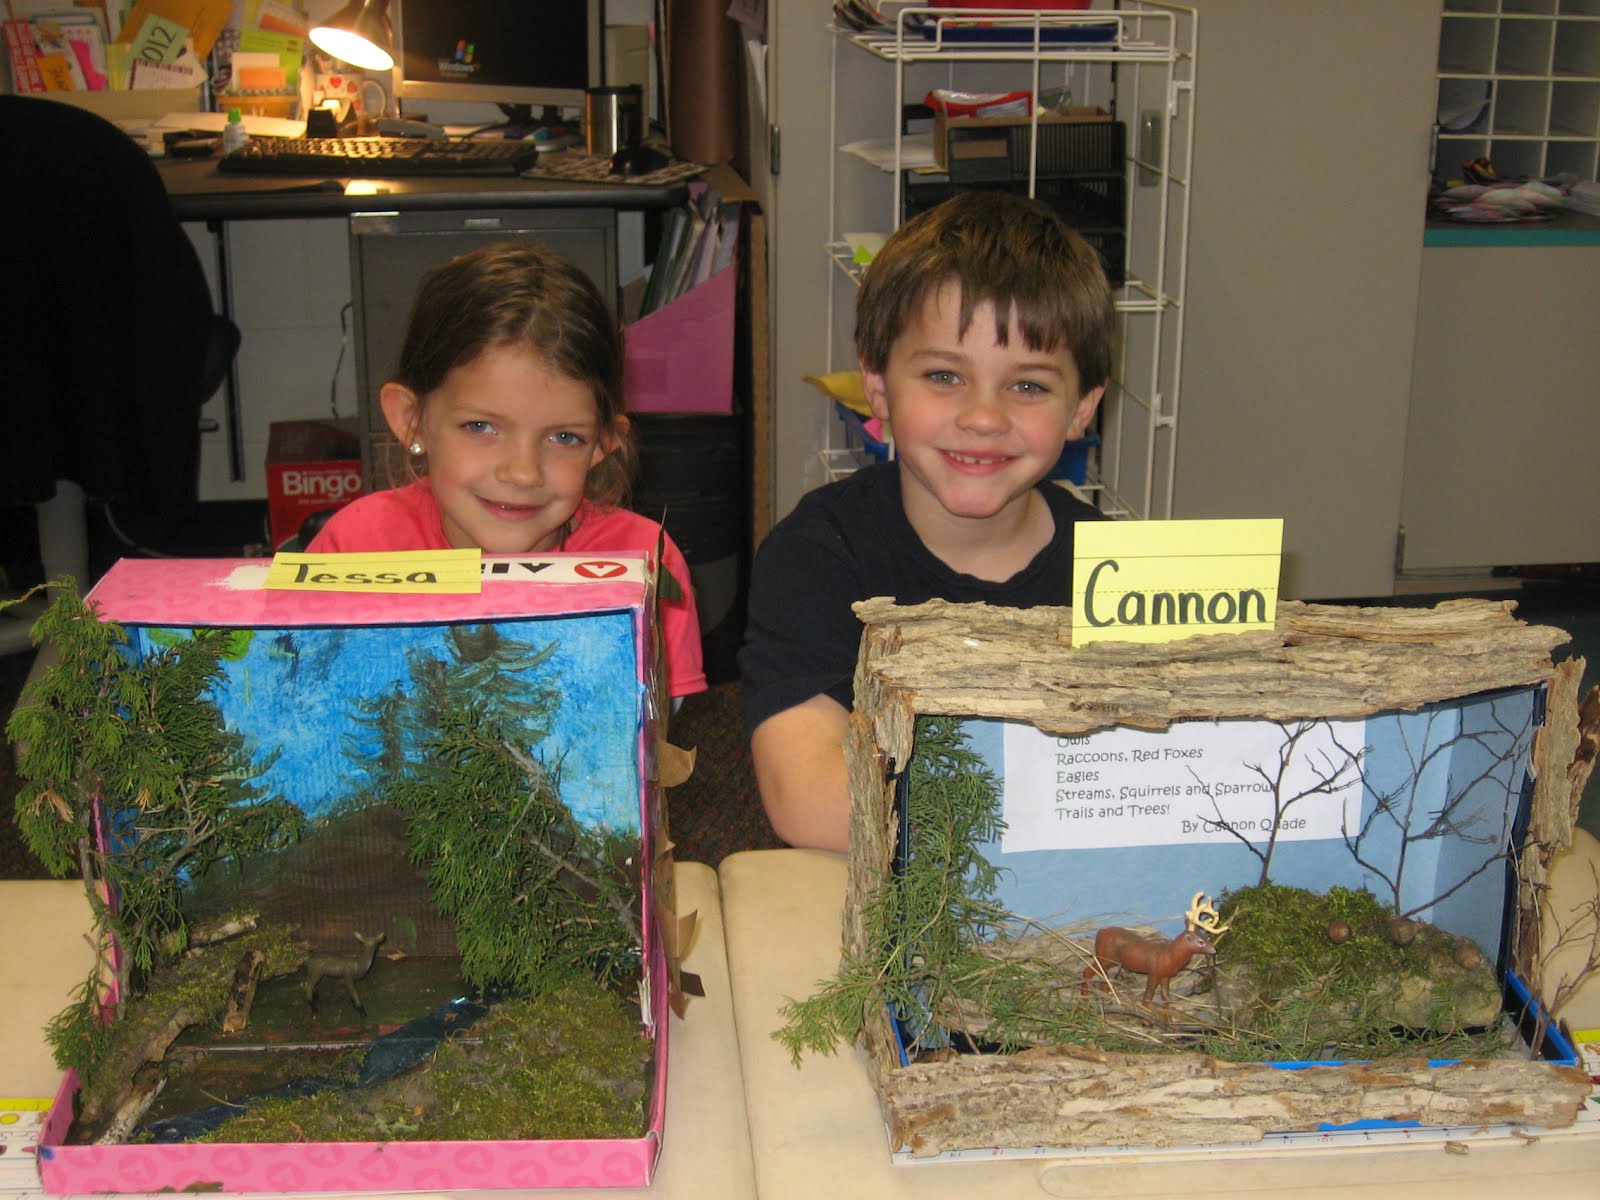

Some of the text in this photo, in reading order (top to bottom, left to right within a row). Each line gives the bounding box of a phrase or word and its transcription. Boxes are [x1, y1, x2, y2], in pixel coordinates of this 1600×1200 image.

[281, 470, 362, 500] Bingo
[280, 562, 437, 585] Tessa
[1084, 559, 1267, 627] Cannon
[1056, 735, 1091, 748] Owls
[1055, 748, 1204, 766] Raccoons, Red Foxes
[1056, 771, 1100, 783] Eagles
[1055, 782, 1277, 803] Streams, Squirrels and Sparrow
[1055, 804, 1171, 820] Trails and Trees!
[1182, 820, 1199, 833] By
[1260, 818, 1307, 832] Qade
